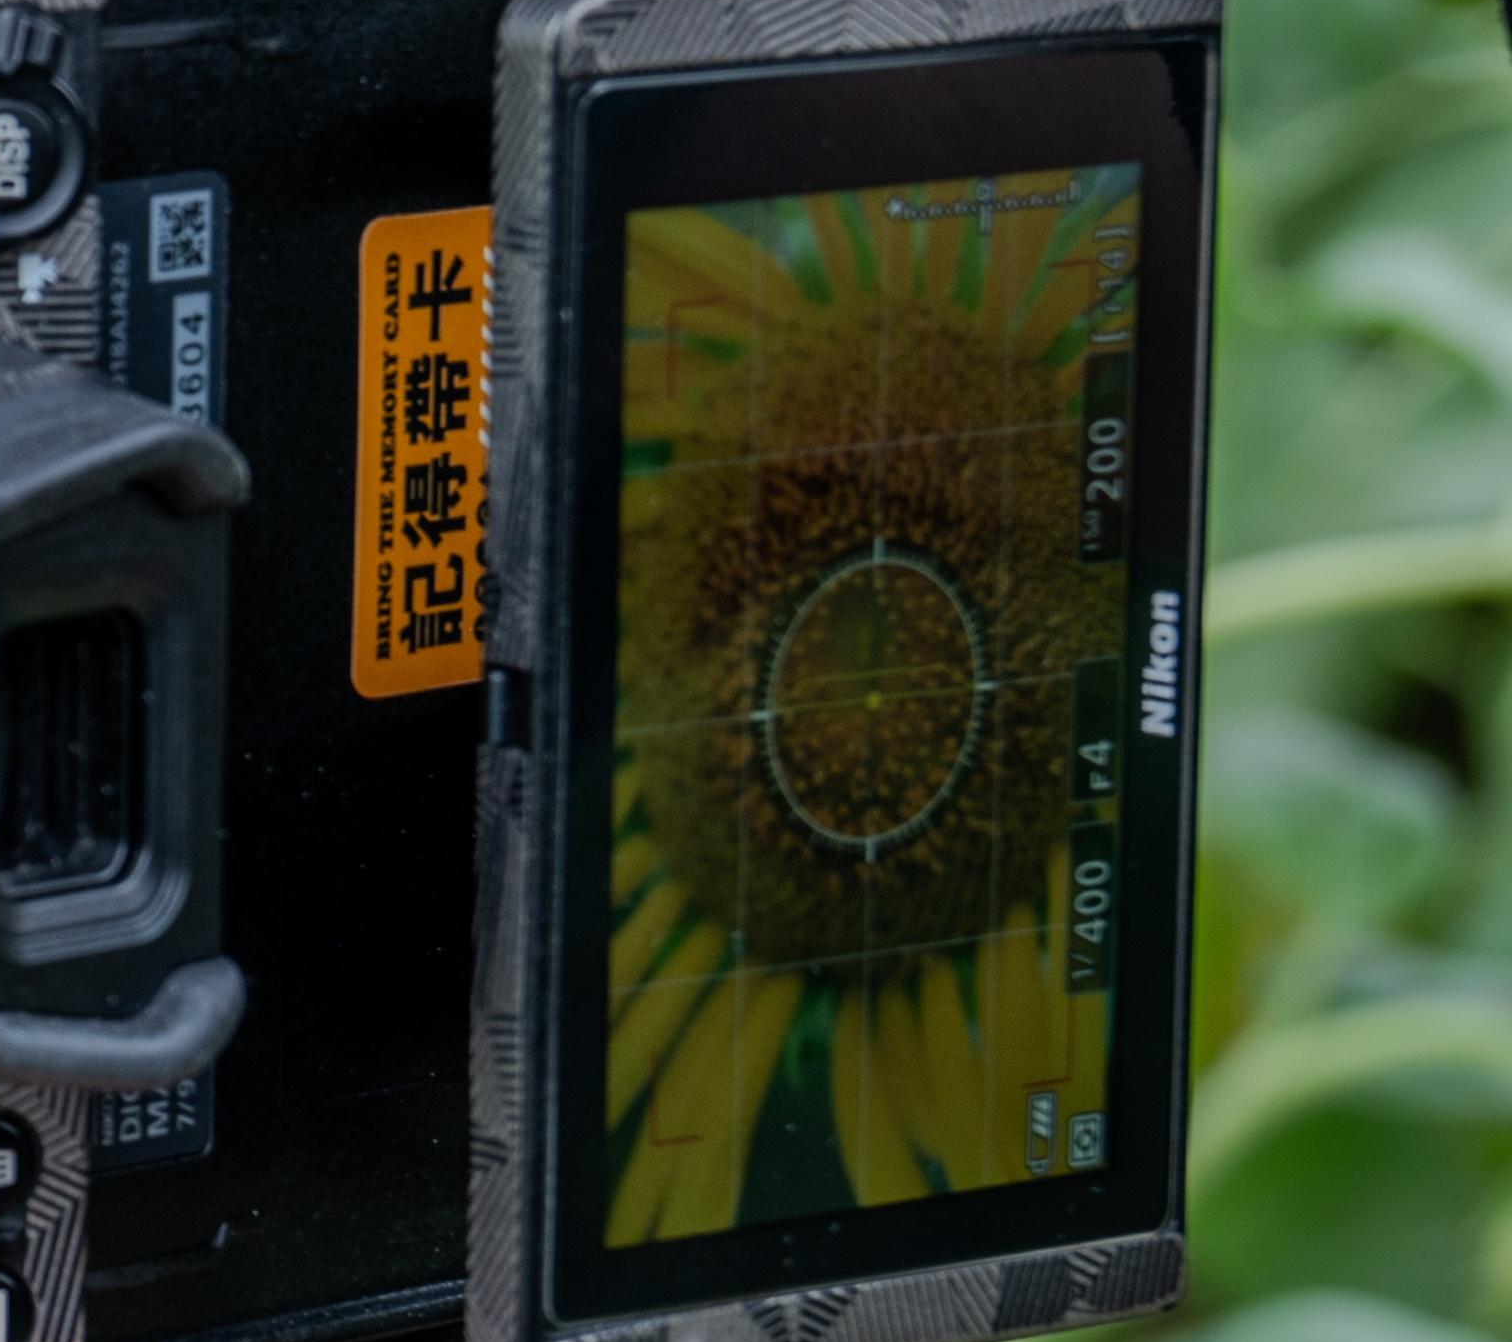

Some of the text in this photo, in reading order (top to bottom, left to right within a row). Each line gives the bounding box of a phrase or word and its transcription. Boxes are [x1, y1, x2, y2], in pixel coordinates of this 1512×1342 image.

[375, 252, 401, 660] BRING THE MEMORY CARD
[400, 249, 472, 653] 記得帶卡
[1088, 417, 1124, 502] 200
[1141, 590, 1179, 737] Nikon
[1077, 737, 1114, 791] F4
